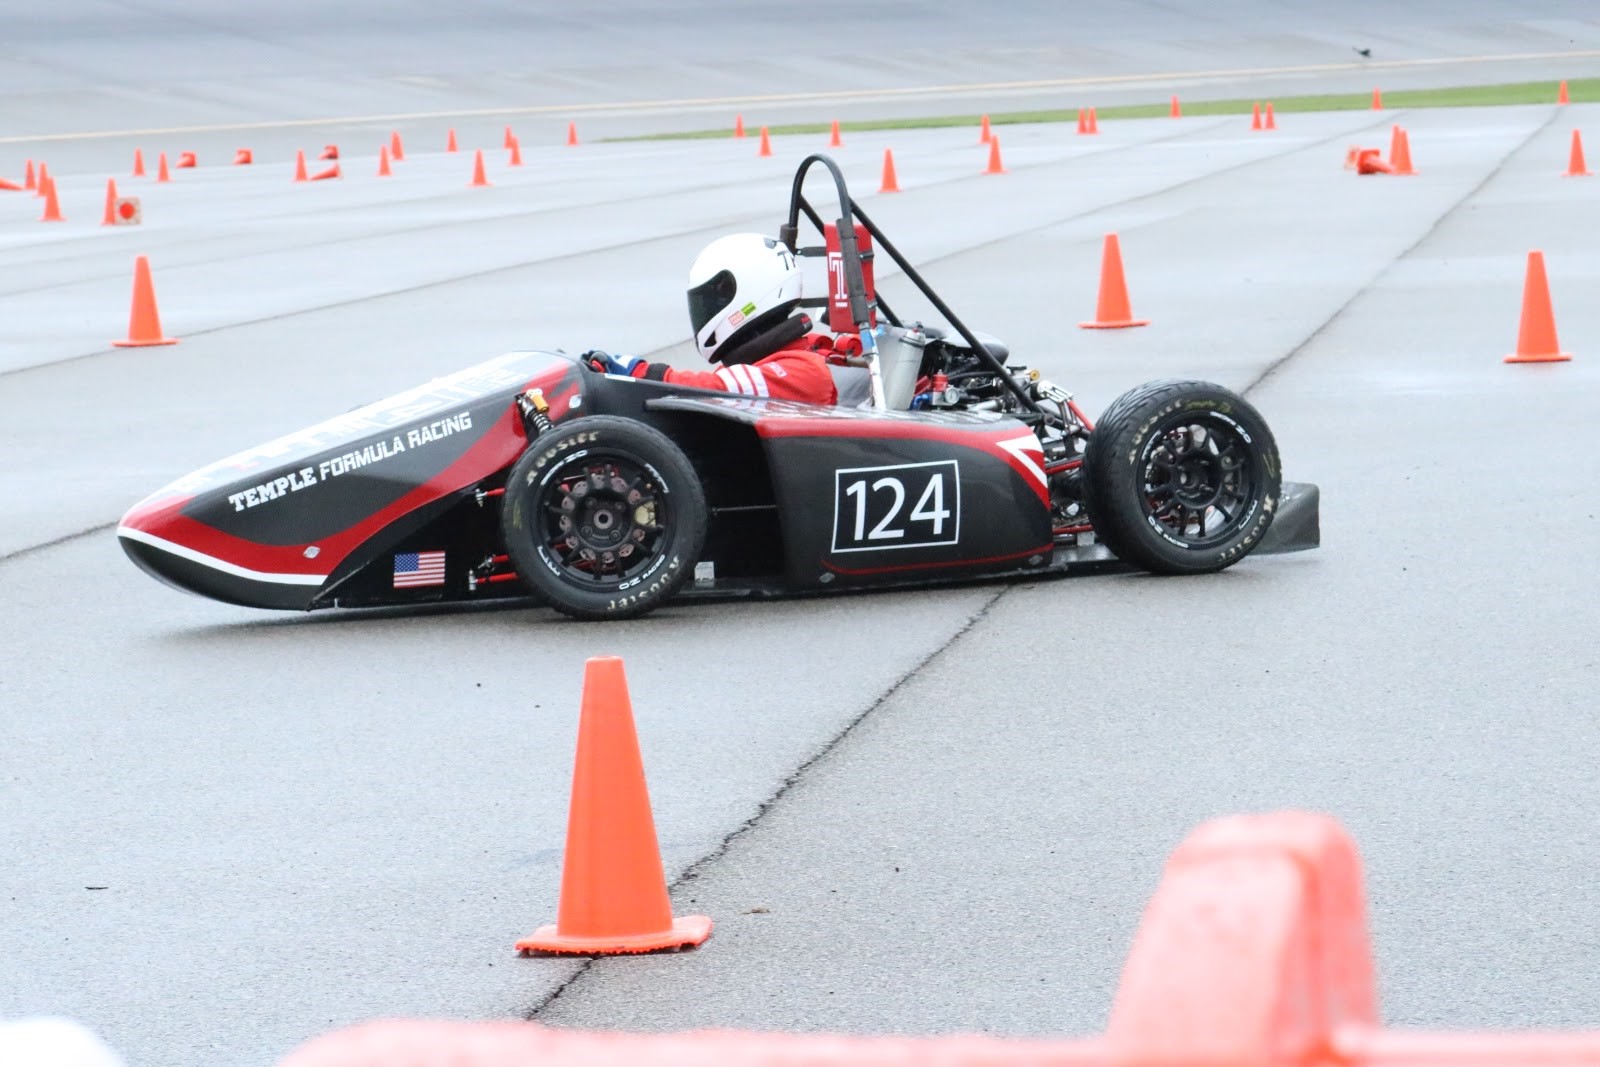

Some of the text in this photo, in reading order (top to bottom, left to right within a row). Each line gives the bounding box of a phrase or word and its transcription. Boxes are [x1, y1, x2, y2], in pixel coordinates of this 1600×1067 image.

[228, 411, 473, 512] TEMPLE FORMULA RACING
[846, 473, 950, 541] 124
